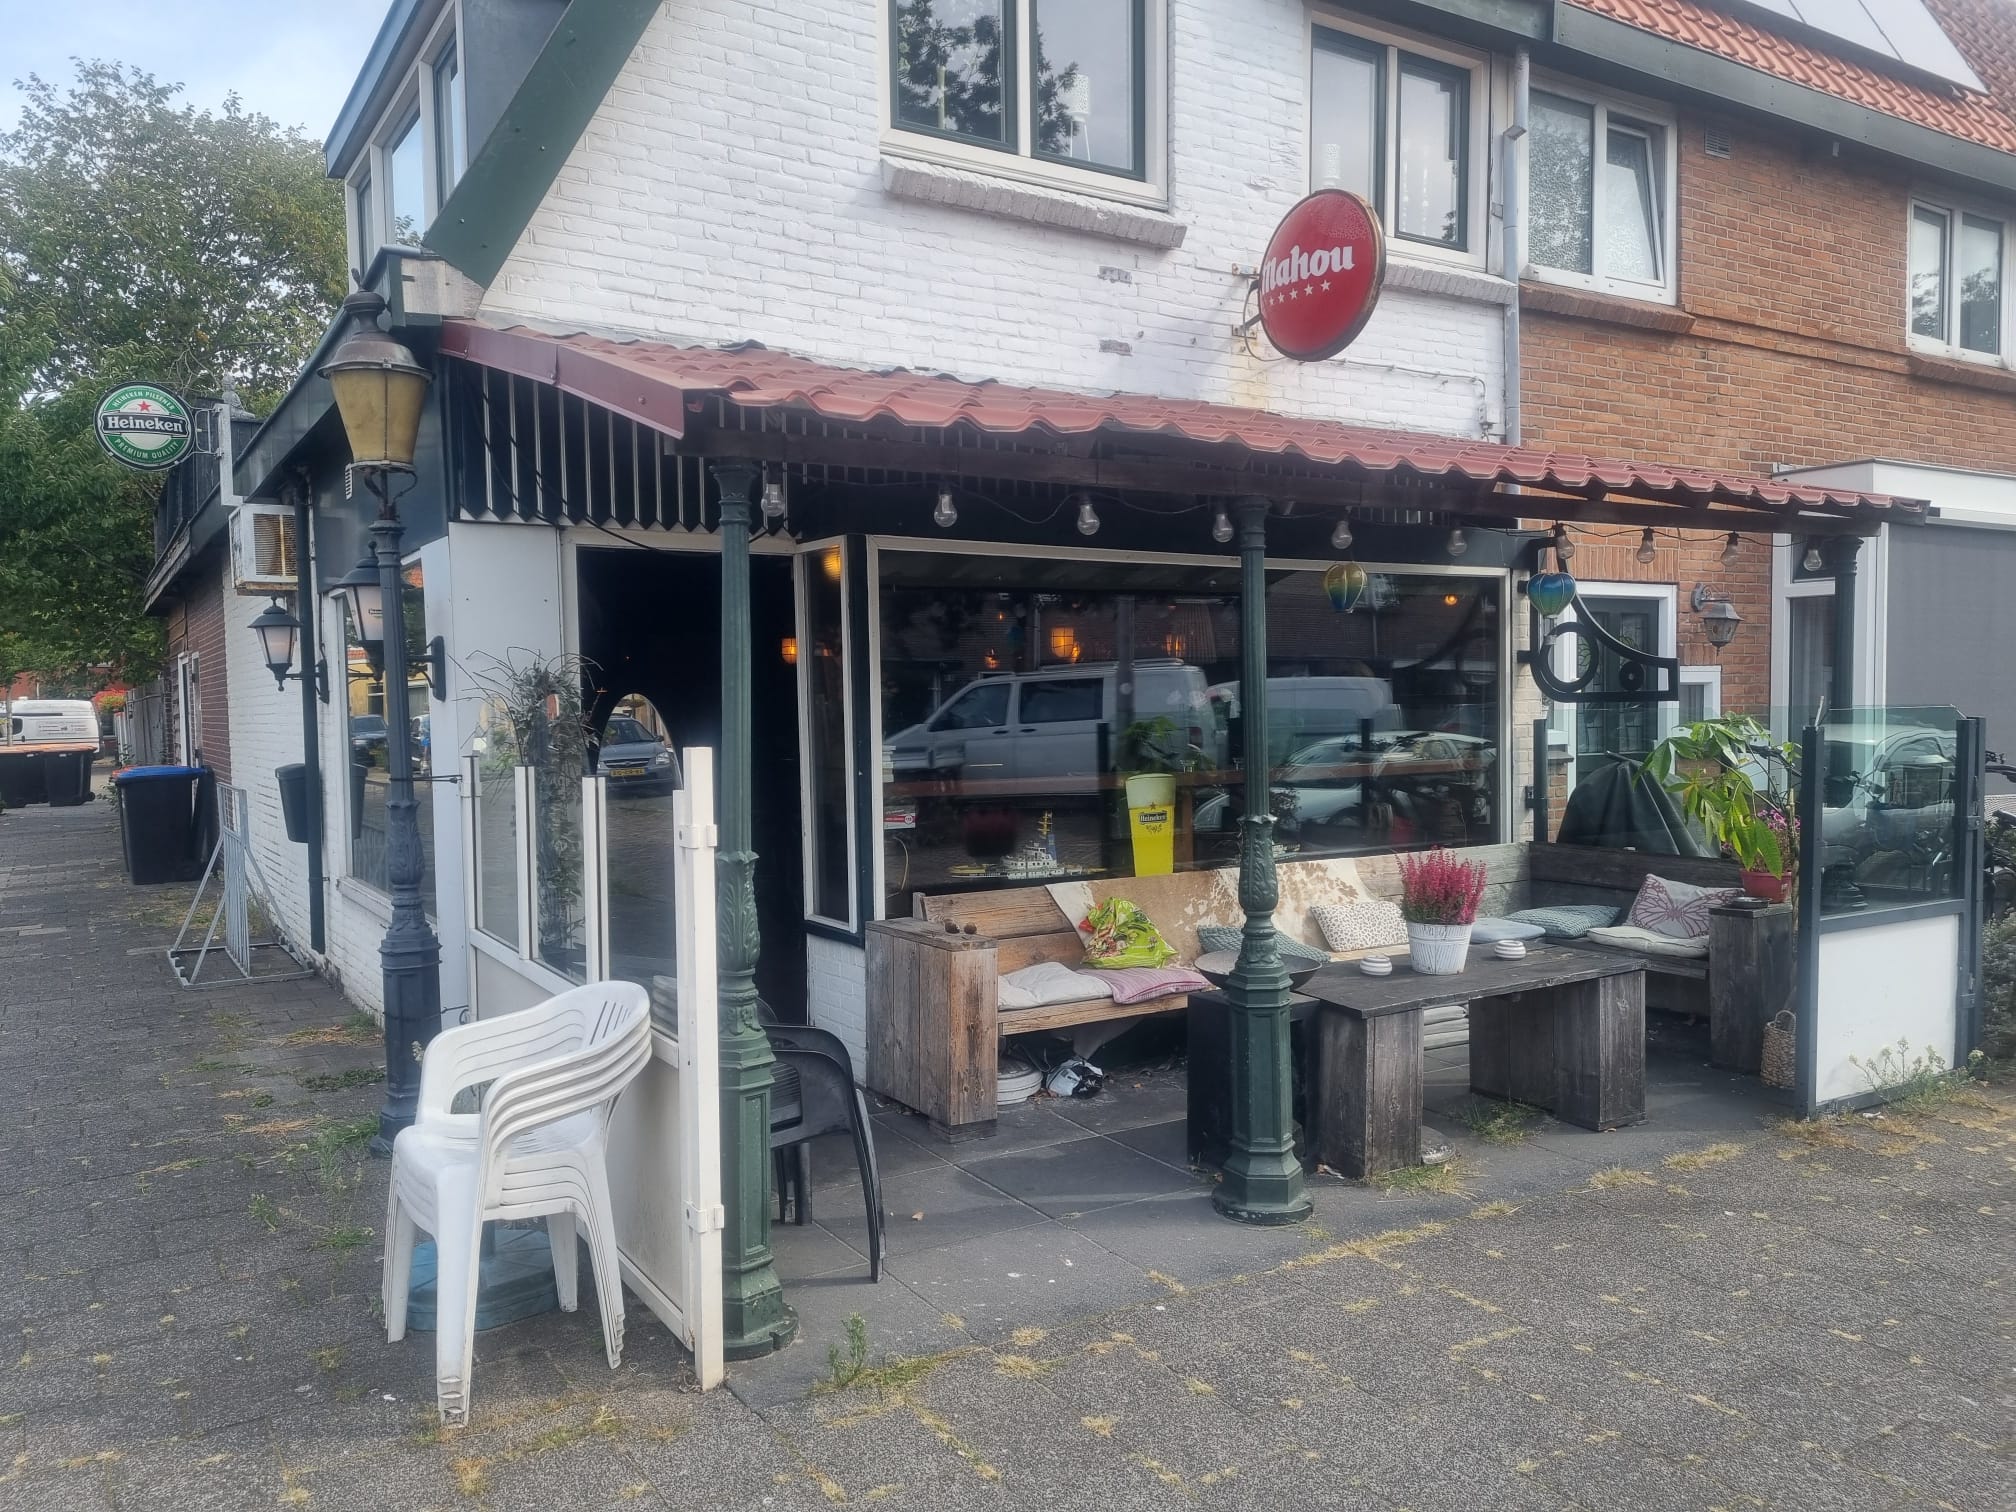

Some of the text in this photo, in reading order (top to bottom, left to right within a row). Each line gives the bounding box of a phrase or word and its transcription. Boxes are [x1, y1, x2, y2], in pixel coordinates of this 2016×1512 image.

[1261, 245, 1355, 294] Mahou
[113, 391, 143, 407] HEINEKEN
[107, 416, 182, 432] Heineken
[114, 439, 179, 458] PREMIUM QUALITY
